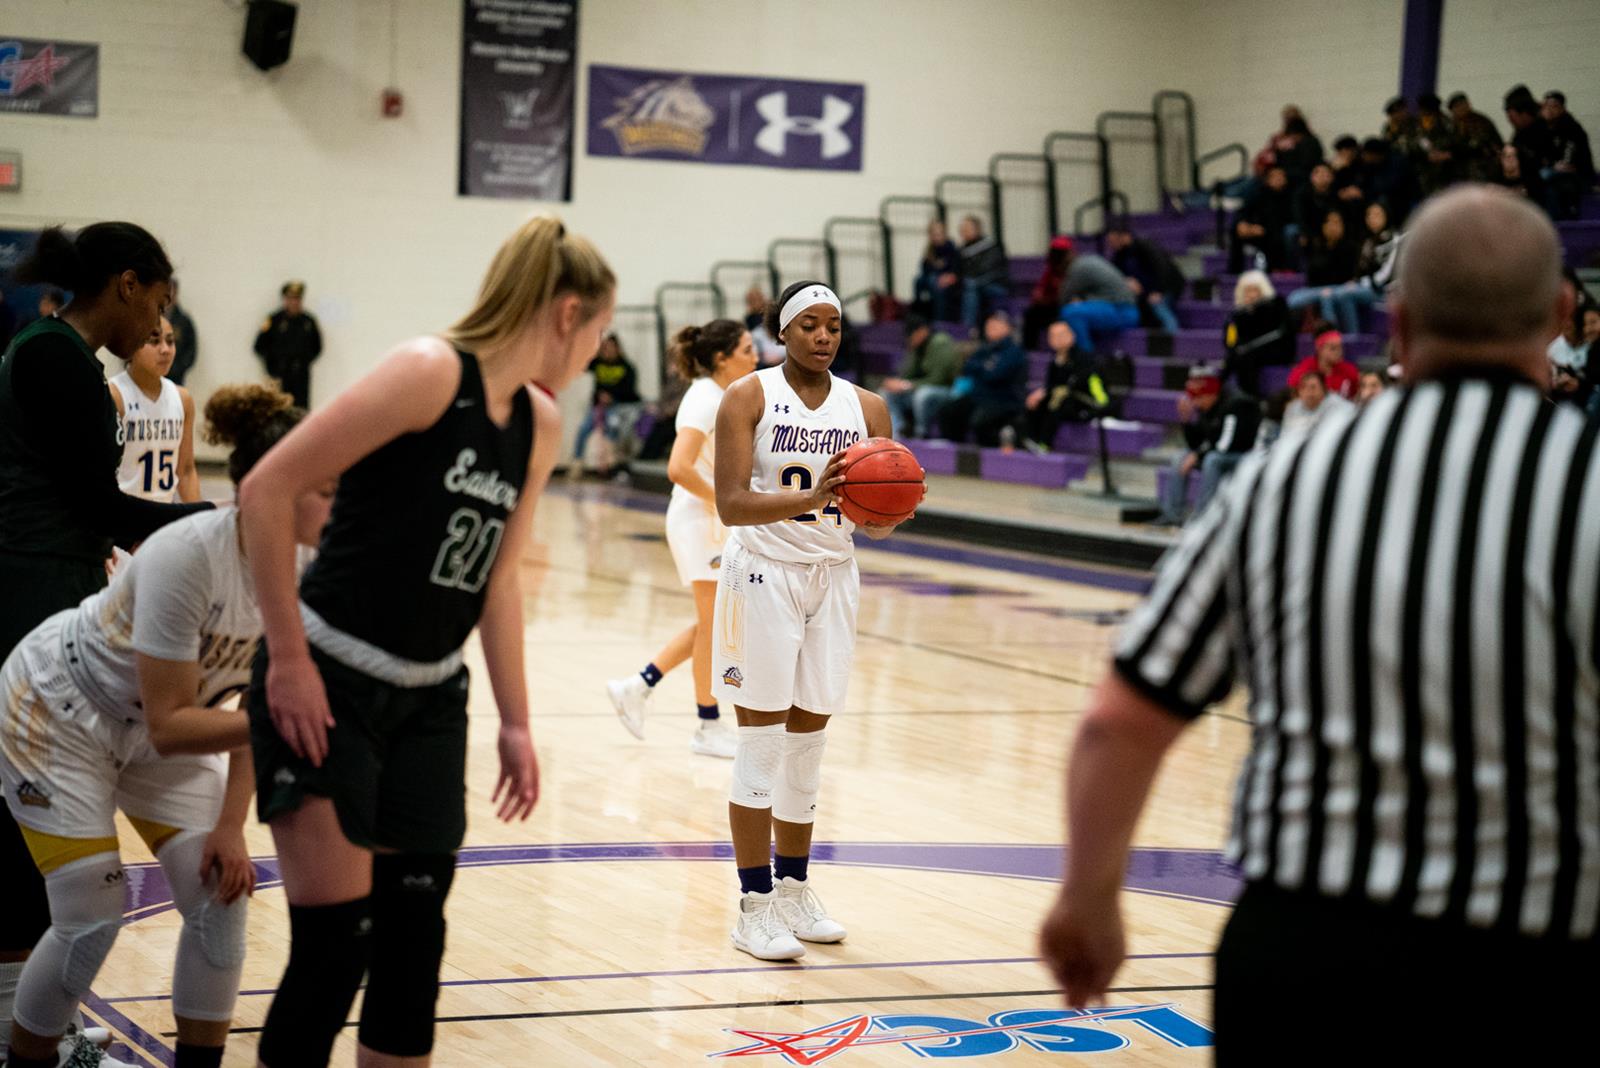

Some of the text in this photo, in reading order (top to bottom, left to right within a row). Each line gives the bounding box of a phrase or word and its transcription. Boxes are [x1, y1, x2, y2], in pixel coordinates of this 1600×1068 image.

[126, 418, 182, 442] MUSTANG
[138, 450, 174, 491] 15
[444, 448, 518, 511] Easter
[430, 507, 505, 593] 21
